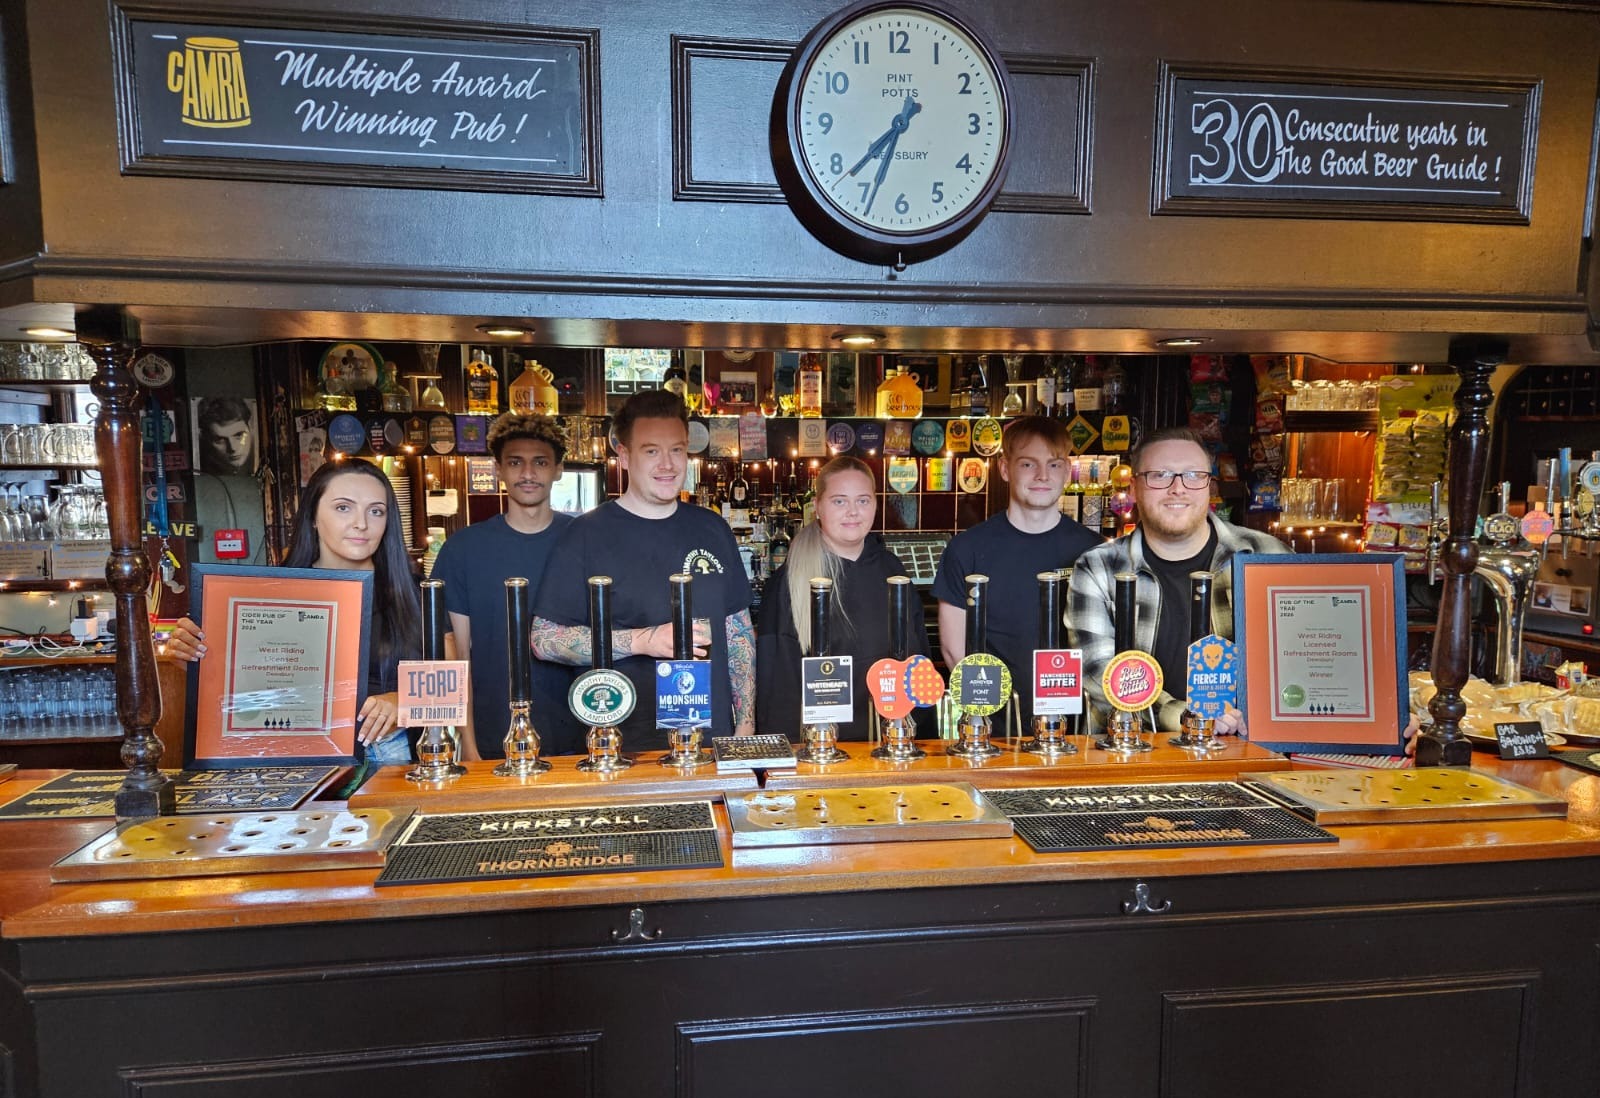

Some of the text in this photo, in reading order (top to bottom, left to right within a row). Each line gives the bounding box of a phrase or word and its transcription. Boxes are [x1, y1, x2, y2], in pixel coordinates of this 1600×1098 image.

[854, 41, 869, 64] 11
[889, 31, 911, 54] 12
[934, 42, 939, 65] 1
[167, 48, 251, 122] CAMRA
[274, 49, 546, 100] Multiple Award
[825, 72, 849, 94] 10
[887, 74, 912, 83] PINT
[957, 72, 972, 94] 2
[881, 88, 918, 98] POTTS
[294, 100, 438, 146] Winning
[818, 112, 833, 135] 9
[967, 113, 980, 134] 3
[1285, 109, 1488, 150] Consecutive years in
[1190, 99, 1284, 184] 30
[830, 152, 843, 175] 8
[955, 153, 972, 174] 4
[1276, 146, 1312, 174] The
[1320, 148, 1369, 177] Good
[1374, 151, 1418, 177] Beer
[857, 182, 870, 203] 7
[931, 182, 944, 203] 5
[895, 193, 909, 215] 6
[281, 647, 305, 655] Riding
[408, 669, 457, 698] IFORD
[576, 676, 602, 695] TIMOTHY
[1040, 678, 1076, 688] BITTER
[1117, 679, 1150, 698] Bitter
[1193, 672, 1232, 684] FIERCE IPA
[659, 694, 709, 705] MOONSHINE
[410, 707, 457, 720] NEW TRADITION
[583, 709, 623, 722] LANDLORD
[1497, 725, 1519, 736] BAR
[1045, 792, 1202, 806] KIRKSTALL
[479, 812, 650, 832] KIRKSTALL
[1104, 828, 1251, 844] THORNBRIDGE
[477, 853, 635, 873] THORNBRIDGE
